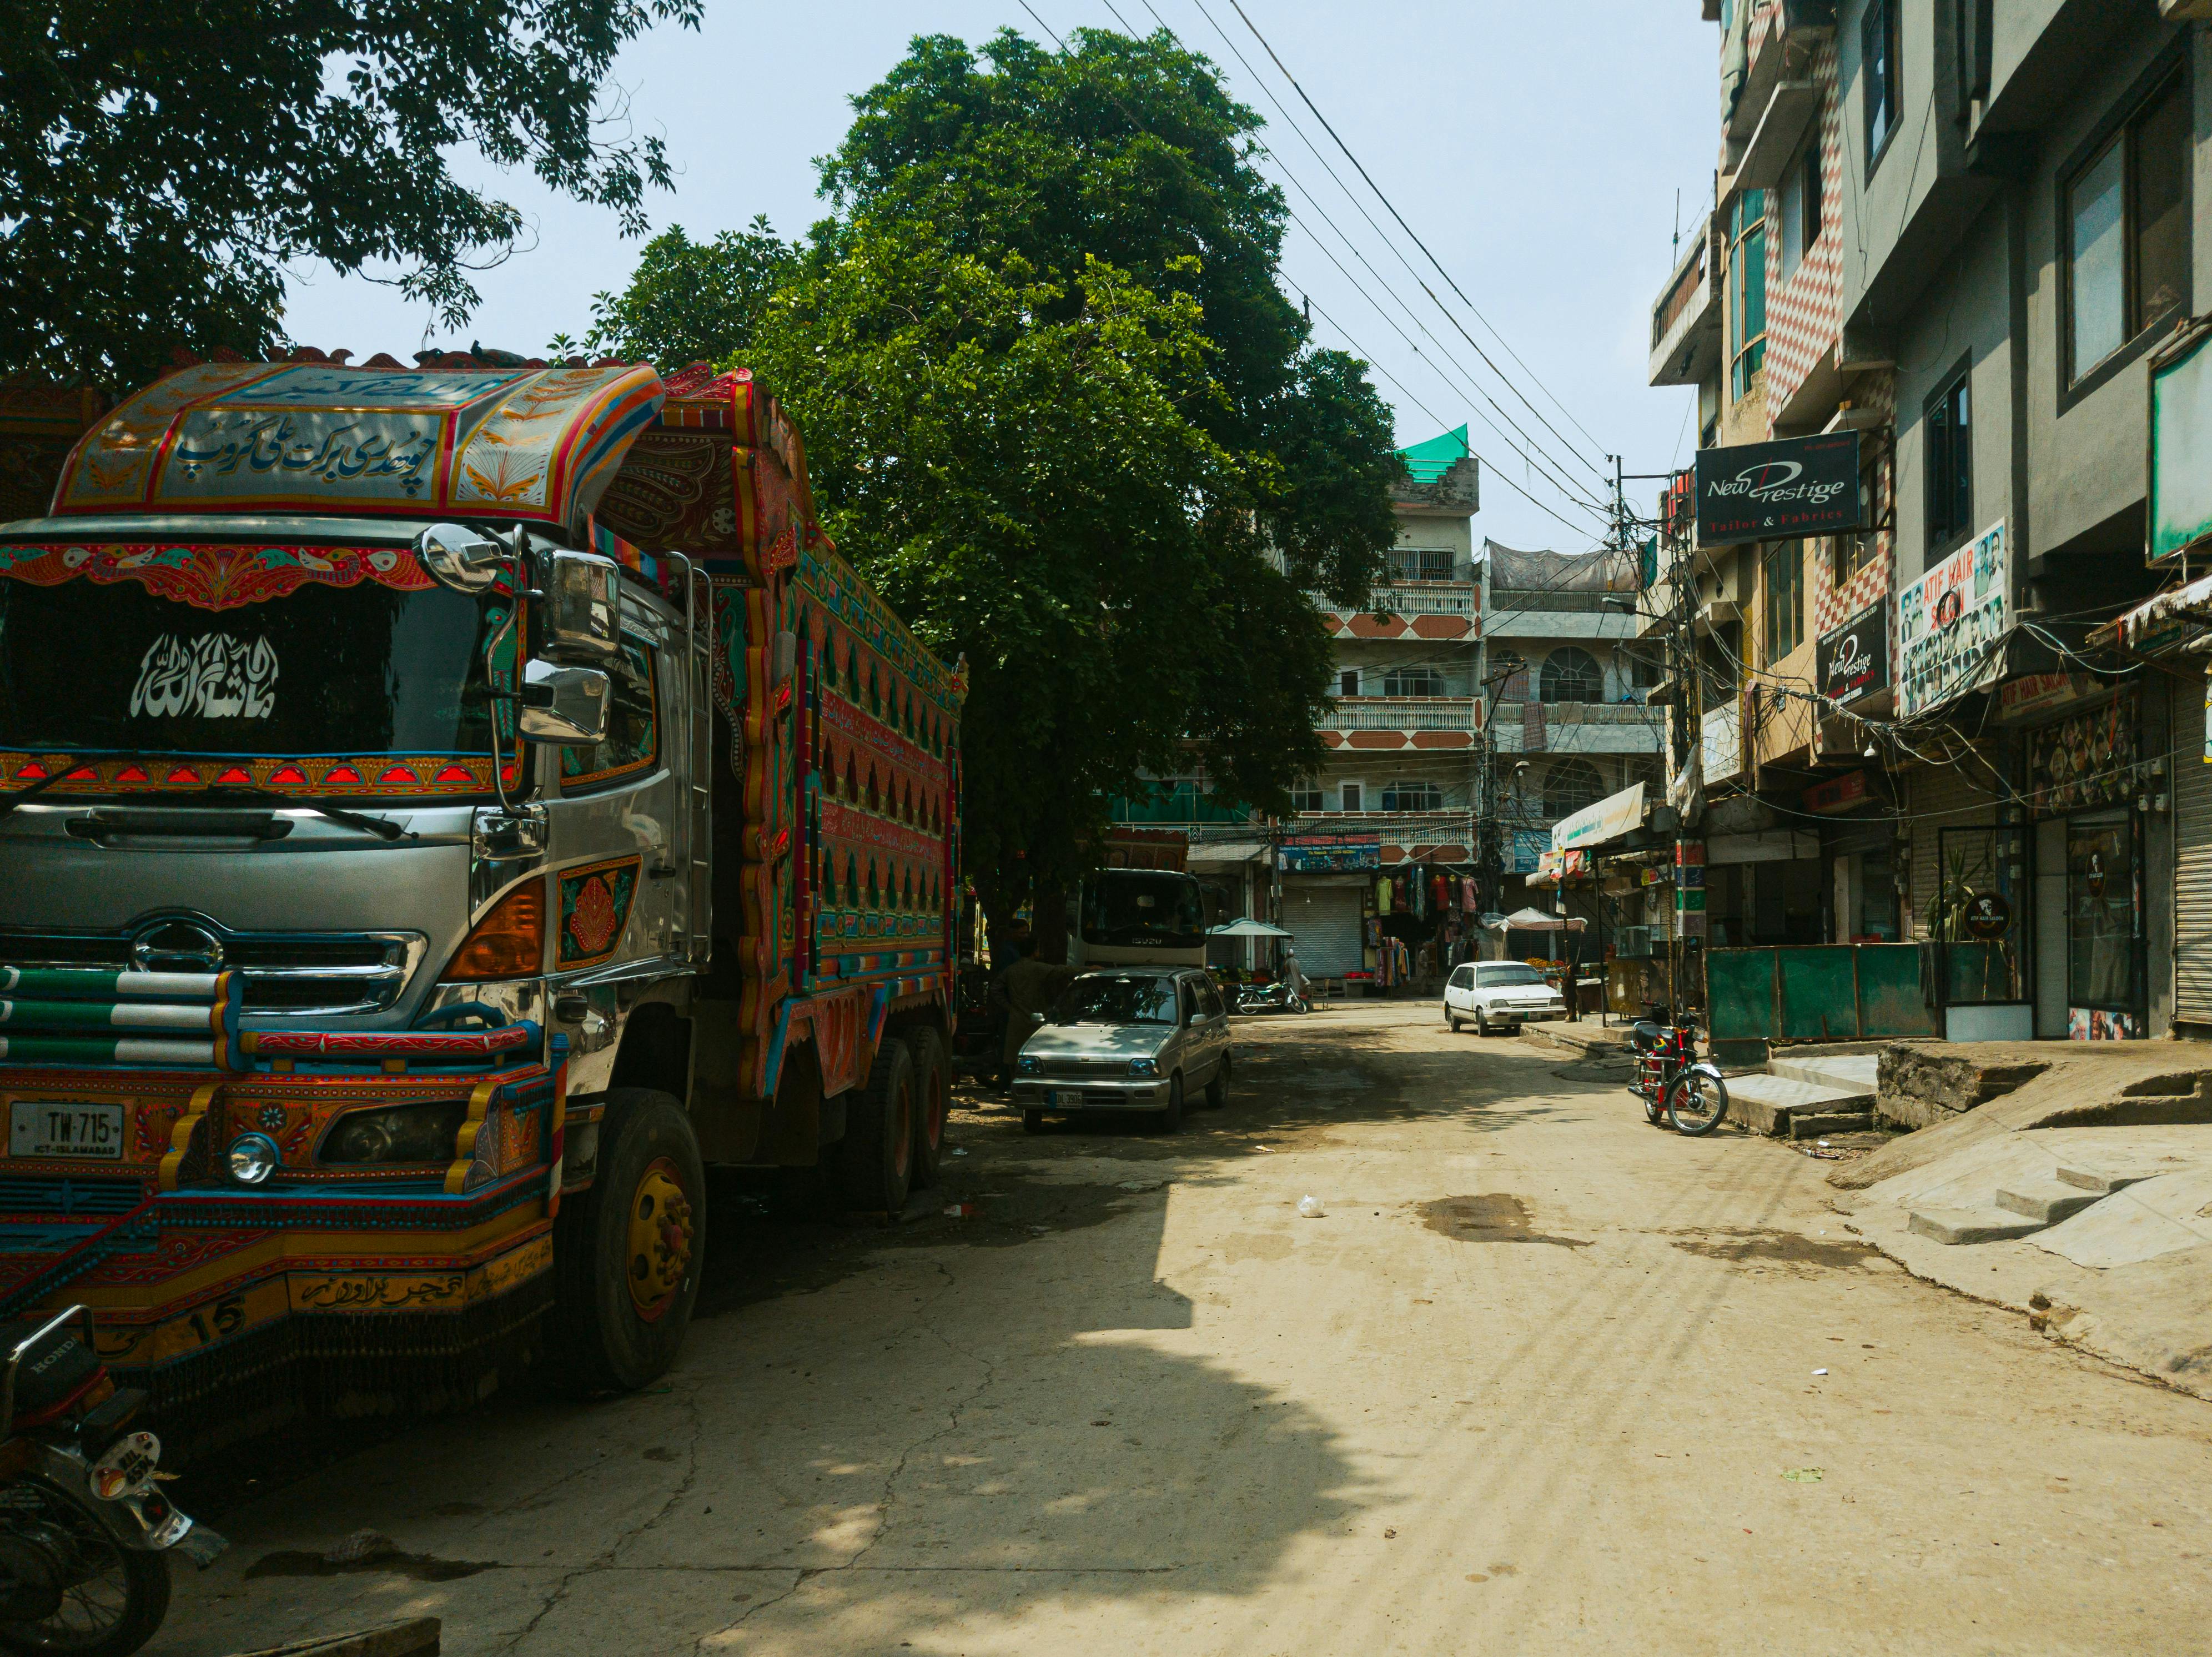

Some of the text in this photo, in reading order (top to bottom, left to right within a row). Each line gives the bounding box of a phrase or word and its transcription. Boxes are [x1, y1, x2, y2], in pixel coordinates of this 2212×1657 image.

[1707, 461, 1844, 504] New Prestige
[1710, 510, 1843, 533] Tailor & Fabrics
[1923, 548, 1973, 606] ATIF HAIR
[1829, 656, 1844, 677] New
[1845, 683, 1849, 692] &
[2003, 683, 2017, 705] ATIF
[2019, 676, 2040, 700] HAIR
[34, 1145, 115, 1154] ICT-ISLAMABAD
